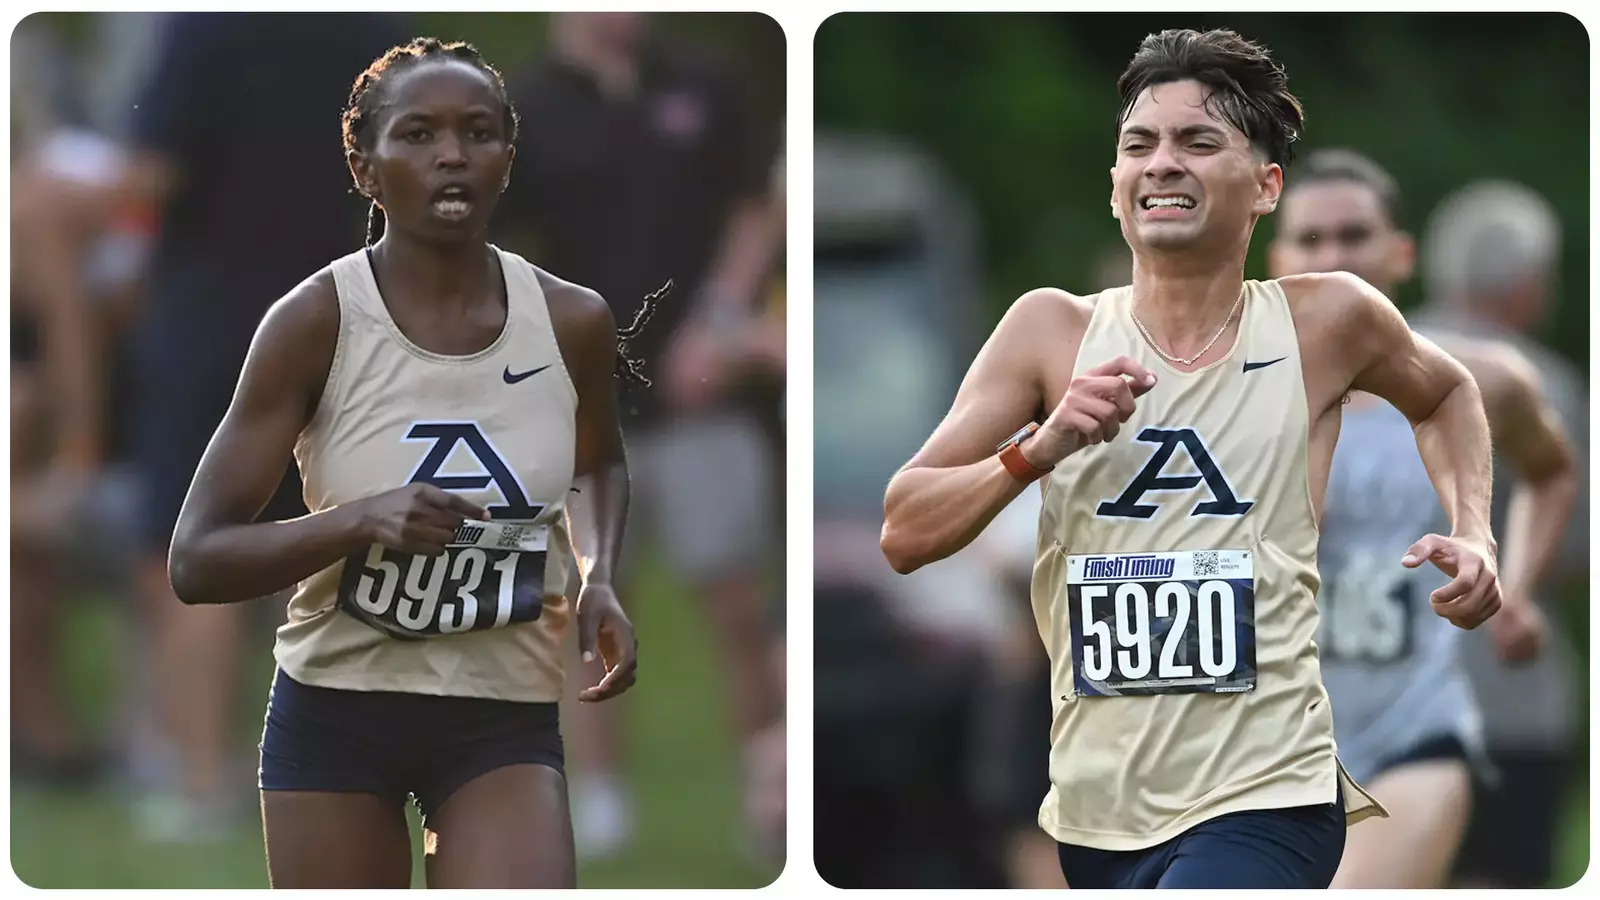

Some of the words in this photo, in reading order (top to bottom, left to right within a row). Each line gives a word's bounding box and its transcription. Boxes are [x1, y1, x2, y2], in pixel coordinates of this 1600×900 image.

[401, 420, 549, 523] A
[1093, 426, 1256, 521] A
[355, 541, 522, 634] 5931
[1083, 555, 1175, 581] FinishTiming
[1080, 580, 1237, 681] 5920
